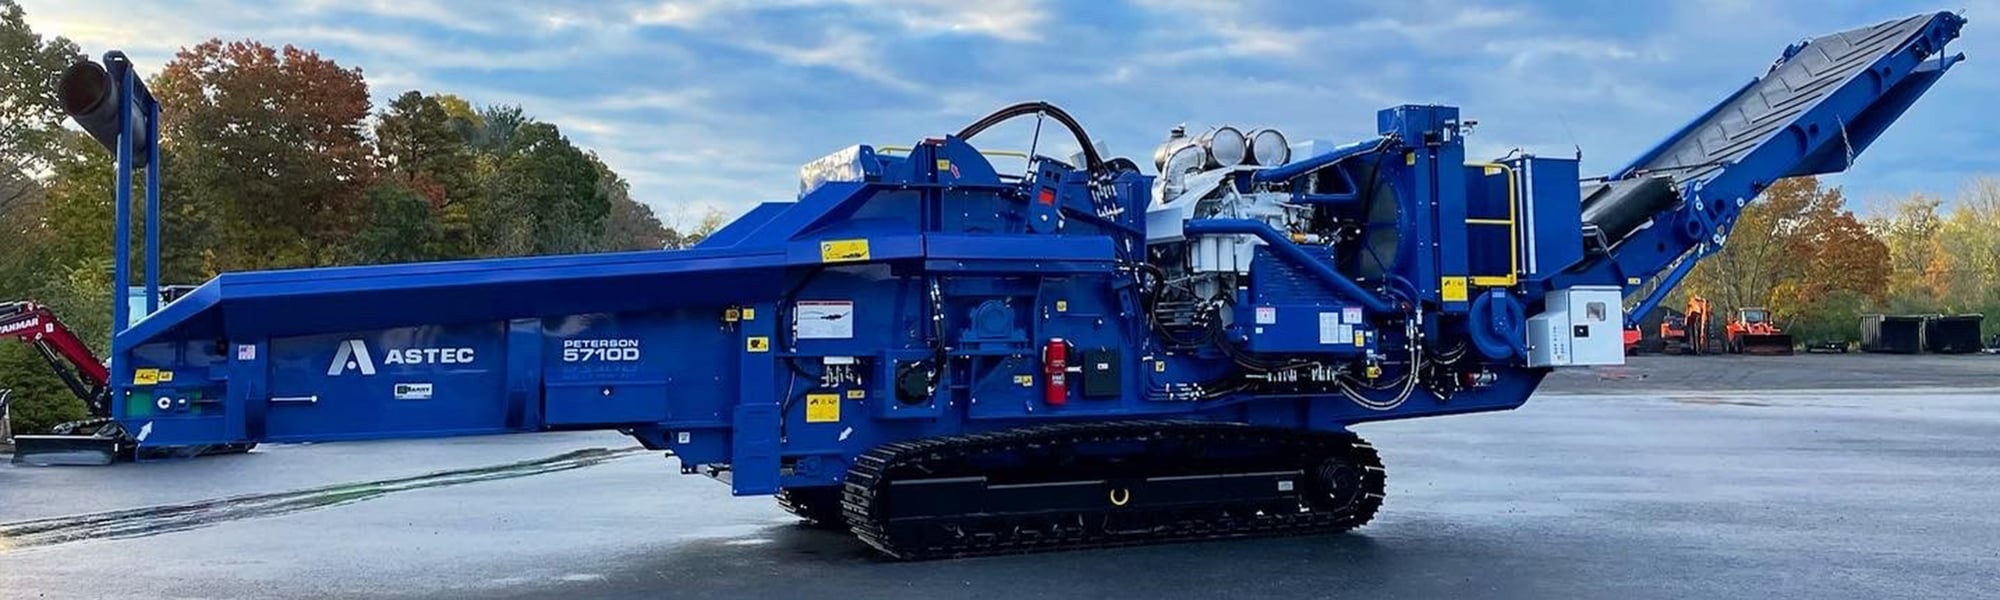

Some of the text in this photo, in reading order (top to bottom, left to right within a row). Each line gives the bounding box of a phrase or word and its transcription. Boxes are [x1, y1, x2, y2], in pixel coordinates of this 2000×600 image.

[564, 339, 639, 348] PETERSON
[384, 348, 474, 364] ASTEC
[563, 348, 640, 361] 5710D
